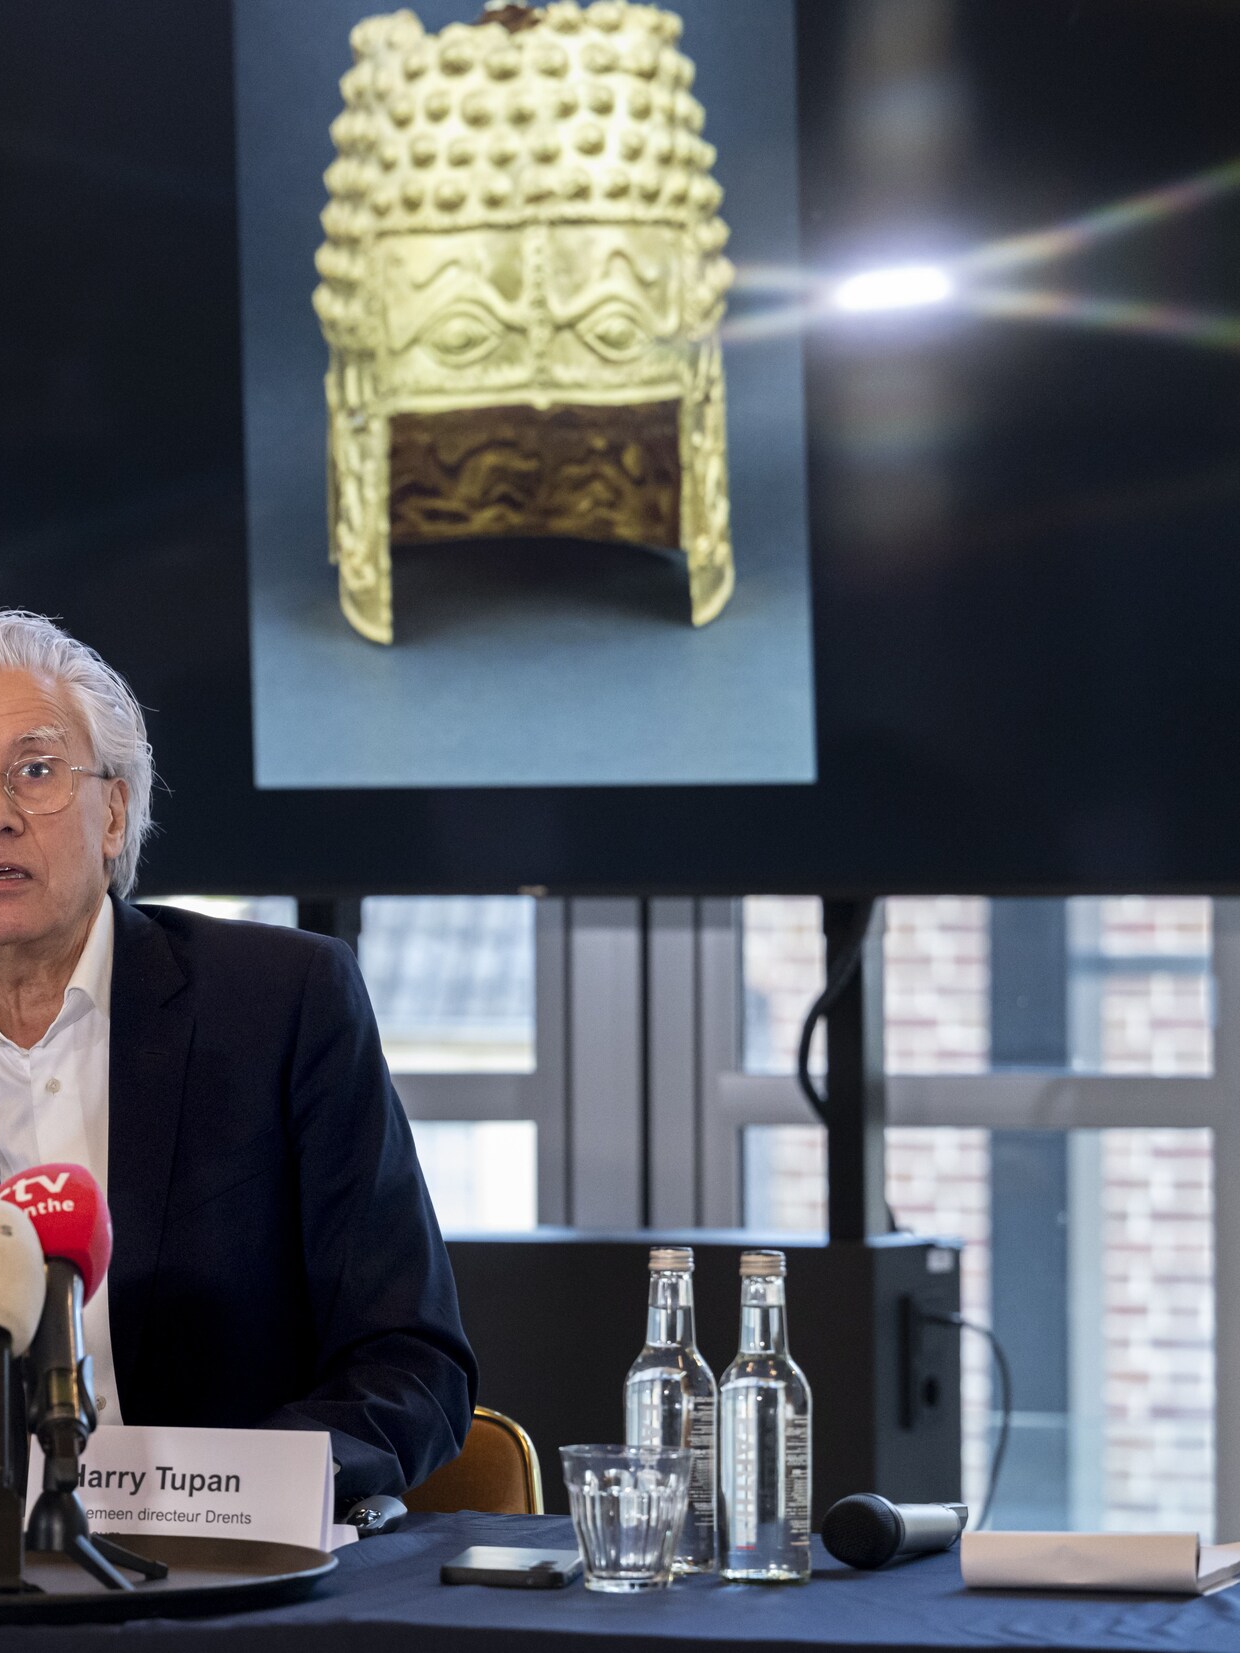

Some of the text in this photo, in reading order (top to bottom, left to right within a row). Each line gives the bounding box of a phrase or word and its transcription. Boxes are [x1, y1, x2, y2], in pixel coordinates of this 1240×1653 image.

[23, 1198, 75, 1217] nthe
[155, 1466, 240, 1497] Tupan
[86, 1508, 252, 1525] emeen directeur Drents
